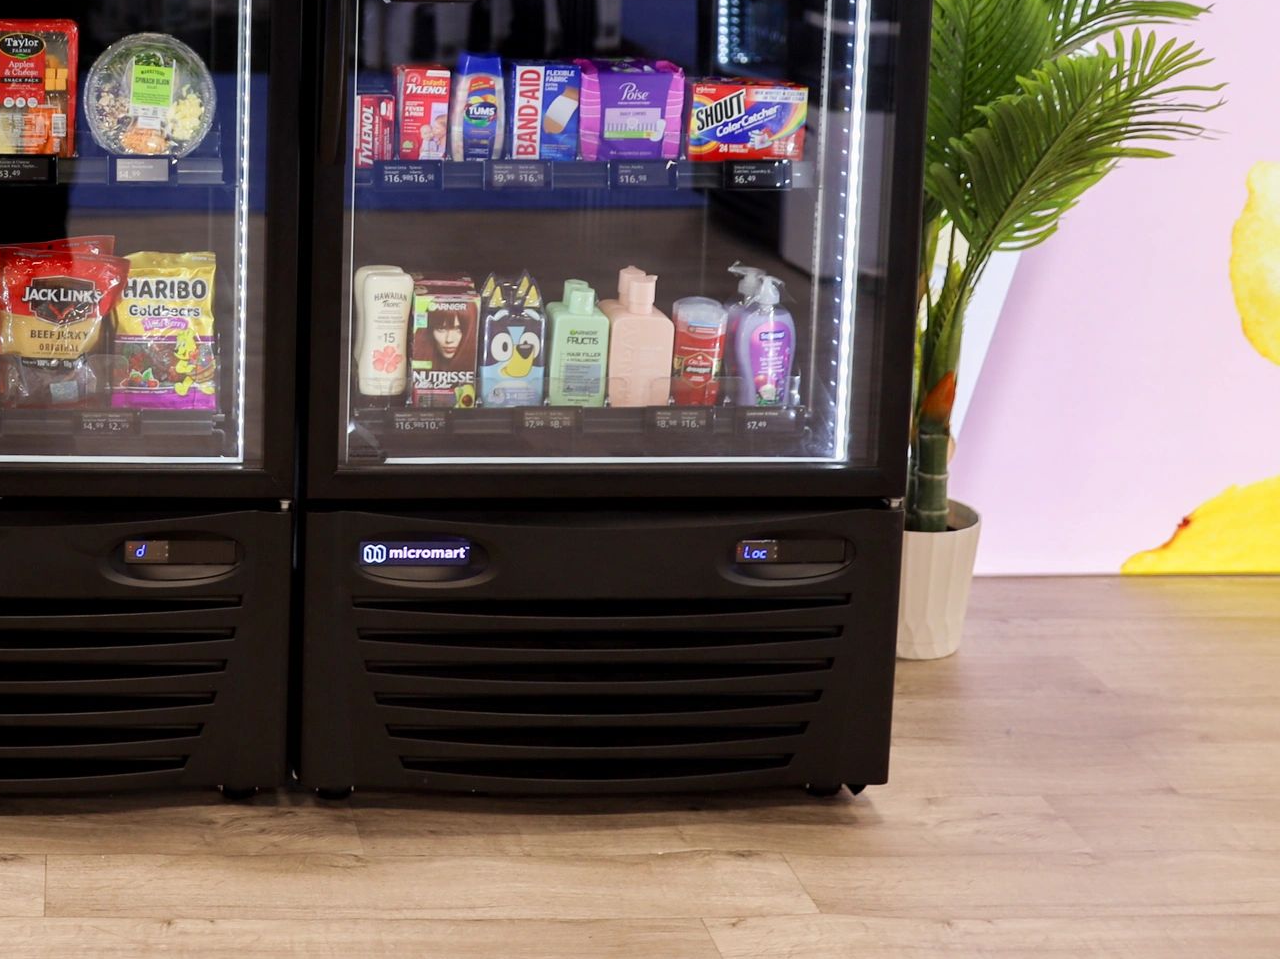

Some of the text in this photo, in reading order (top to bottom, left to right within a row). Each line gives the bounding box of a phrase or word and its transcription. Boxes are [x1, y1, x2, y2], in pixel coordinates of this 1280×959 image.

[5, 36, 39, 49] Taylor
[8, 60, 35, 70] Apples
[546, 70, 575, 78] FLEXIBLE
[406, 83, 447, 95] TYLENOL
[619, 82, 649, 101] Poise
[468, 106, 495, 116] TUMS
[516, 69, 542, 160] BAND-AID
[696, 91, 746, 131] SHOUT
[360, 105, 374, 165] TYLENOL
[22, 287, 58, 302] JACK
[124, 279, 207, 299] HARIBO
[129, 304, 200, 318] Goldbears
[30, 329, 55, 339] BEEF
[383, 332, 396, 343] 15
[413, 371, 474, 383] NUTRISSE
[743, 546, 767, 560] Loc
